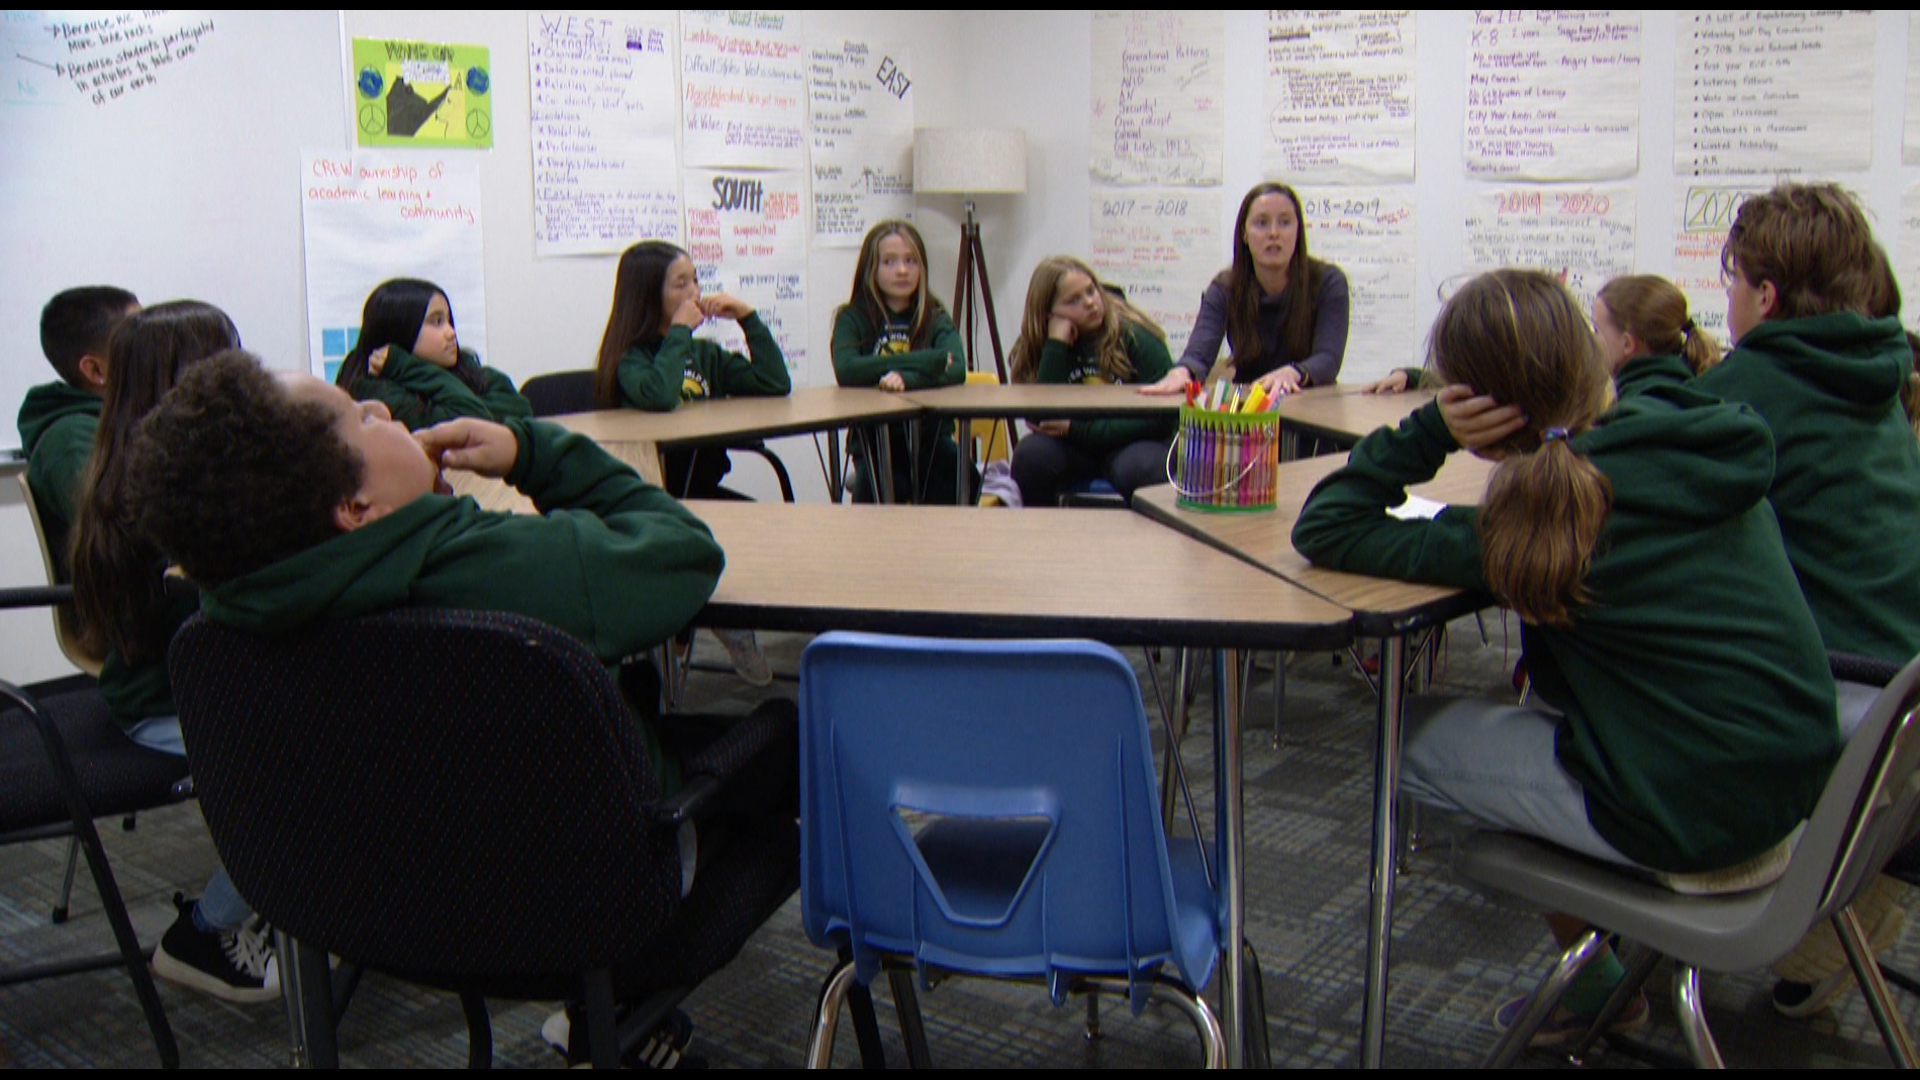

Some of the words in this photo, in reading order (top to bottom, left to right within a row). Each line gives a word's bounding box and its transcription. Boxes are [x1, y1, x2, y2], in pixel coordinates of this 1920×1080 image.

[63, 18, 115, 39] Because
[541, 15, 612, 38] WEST
[1471, 28, 1500, 46] K-8
[67, 56, 113, 80] Because
[115, 39, 160, 65] students
[162, 18, 215, 50] participated
[92, 66, 133, 88] activities
[875, 55, 912, 100] EAST
[1468, 110, 1488, 124] City
[312, 158, 353, 178] CREW
[359, 165, 418, 183] ownership
[428, 161, 445, 179] of
[308, 185, 371, 200] academic
[377, 186, 423, 207] learning
[712, 175, 764, 214] SOUTH
[1494, 190, 1543, 215] 2019
[1555, 190, 1611, 216] 2020
[400, 203, 475, 225] community
[1102, 200, 1136, 217] 2017
[1154, 200, 1189, 217] 2018
[1306, 197, 1380, 216] 018-2019
